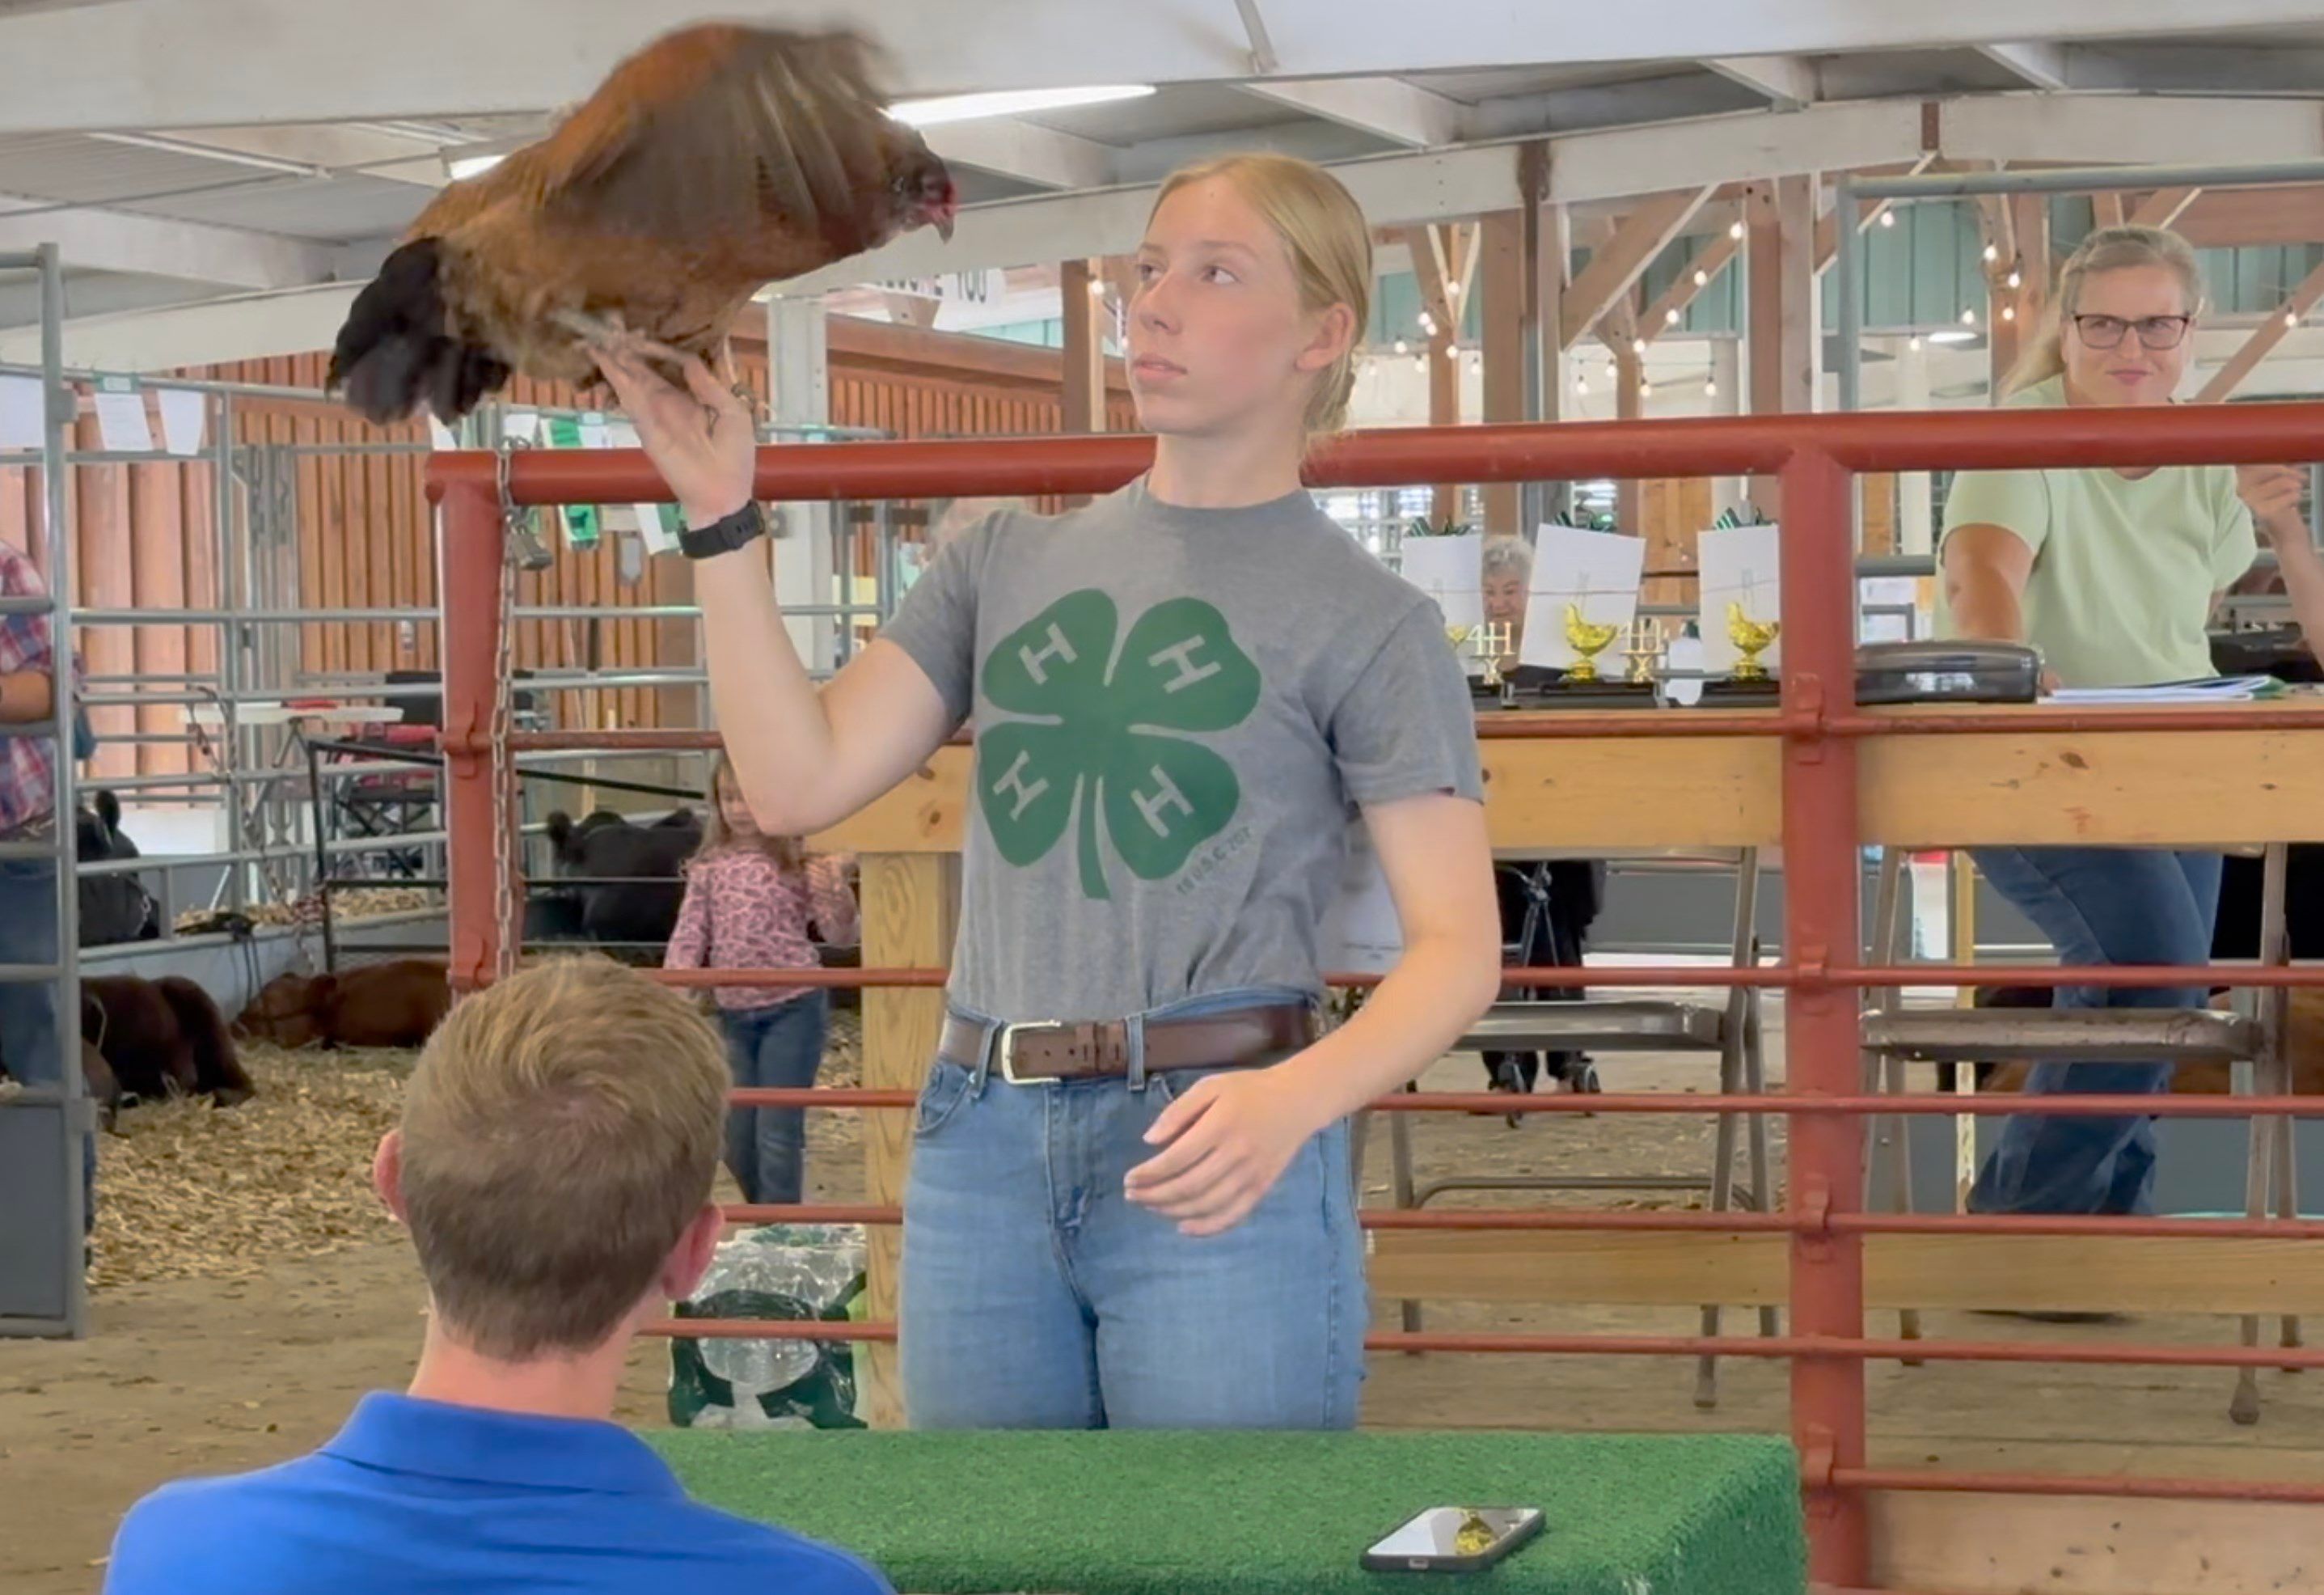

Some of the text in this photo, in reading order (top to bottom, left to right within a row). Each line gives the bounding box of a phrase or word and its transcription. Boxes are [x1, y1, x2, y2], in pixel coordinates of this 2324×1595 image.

[1019, 624, 1077, 685] H
[1150, 634, 1220, 693] H
[992, 751, 1049, 821] H
[1131, 765, 1194, 837] H
